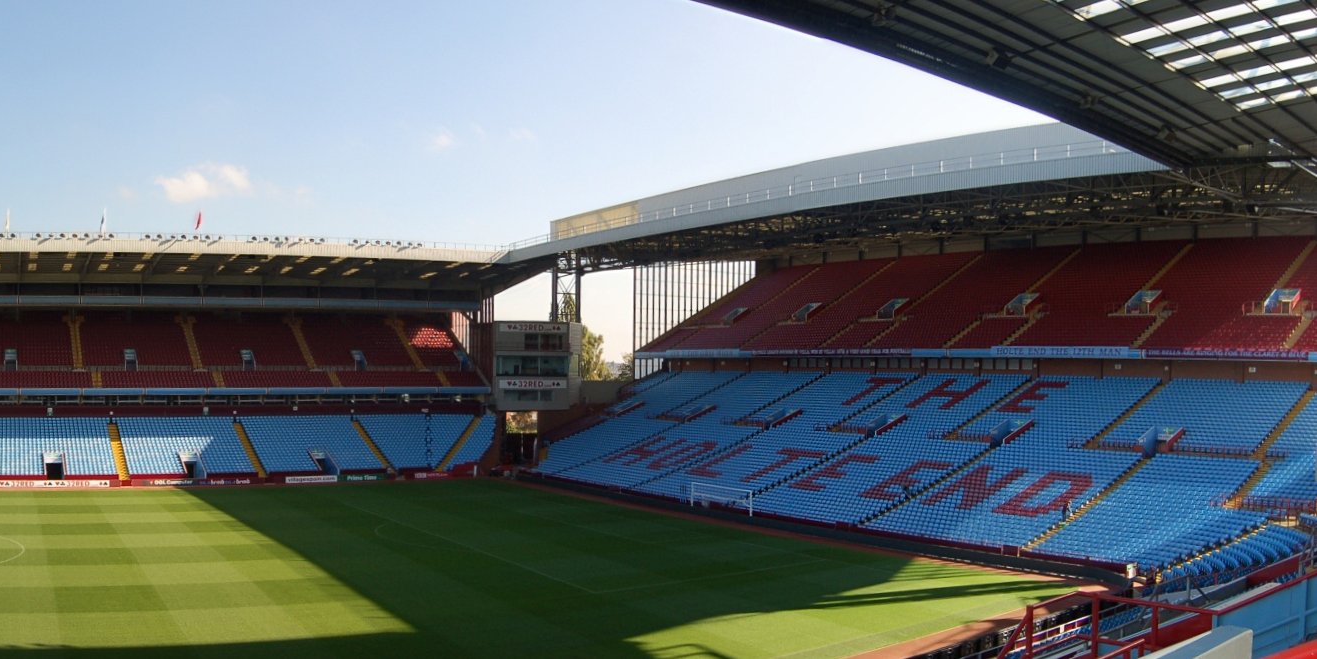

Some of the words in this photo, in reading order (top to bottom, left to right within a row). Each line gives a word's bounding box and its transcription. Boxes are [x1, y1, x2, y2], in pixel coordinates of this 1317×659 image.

[996, 347, 1024, 356] HOLTE
[1028, 348, 1047, 356] END
[1050, 348, 1068, 356] THE
[1073, 348, 1095, 356] 12TH
[1099, 348, 1122, 357] MAN
[518, 380, 544, 388] 32RED
[841, 376, 1070, 412] THE
[603, 435, 879, 493] HOLTE
[857, 460, 1094, 517] END
